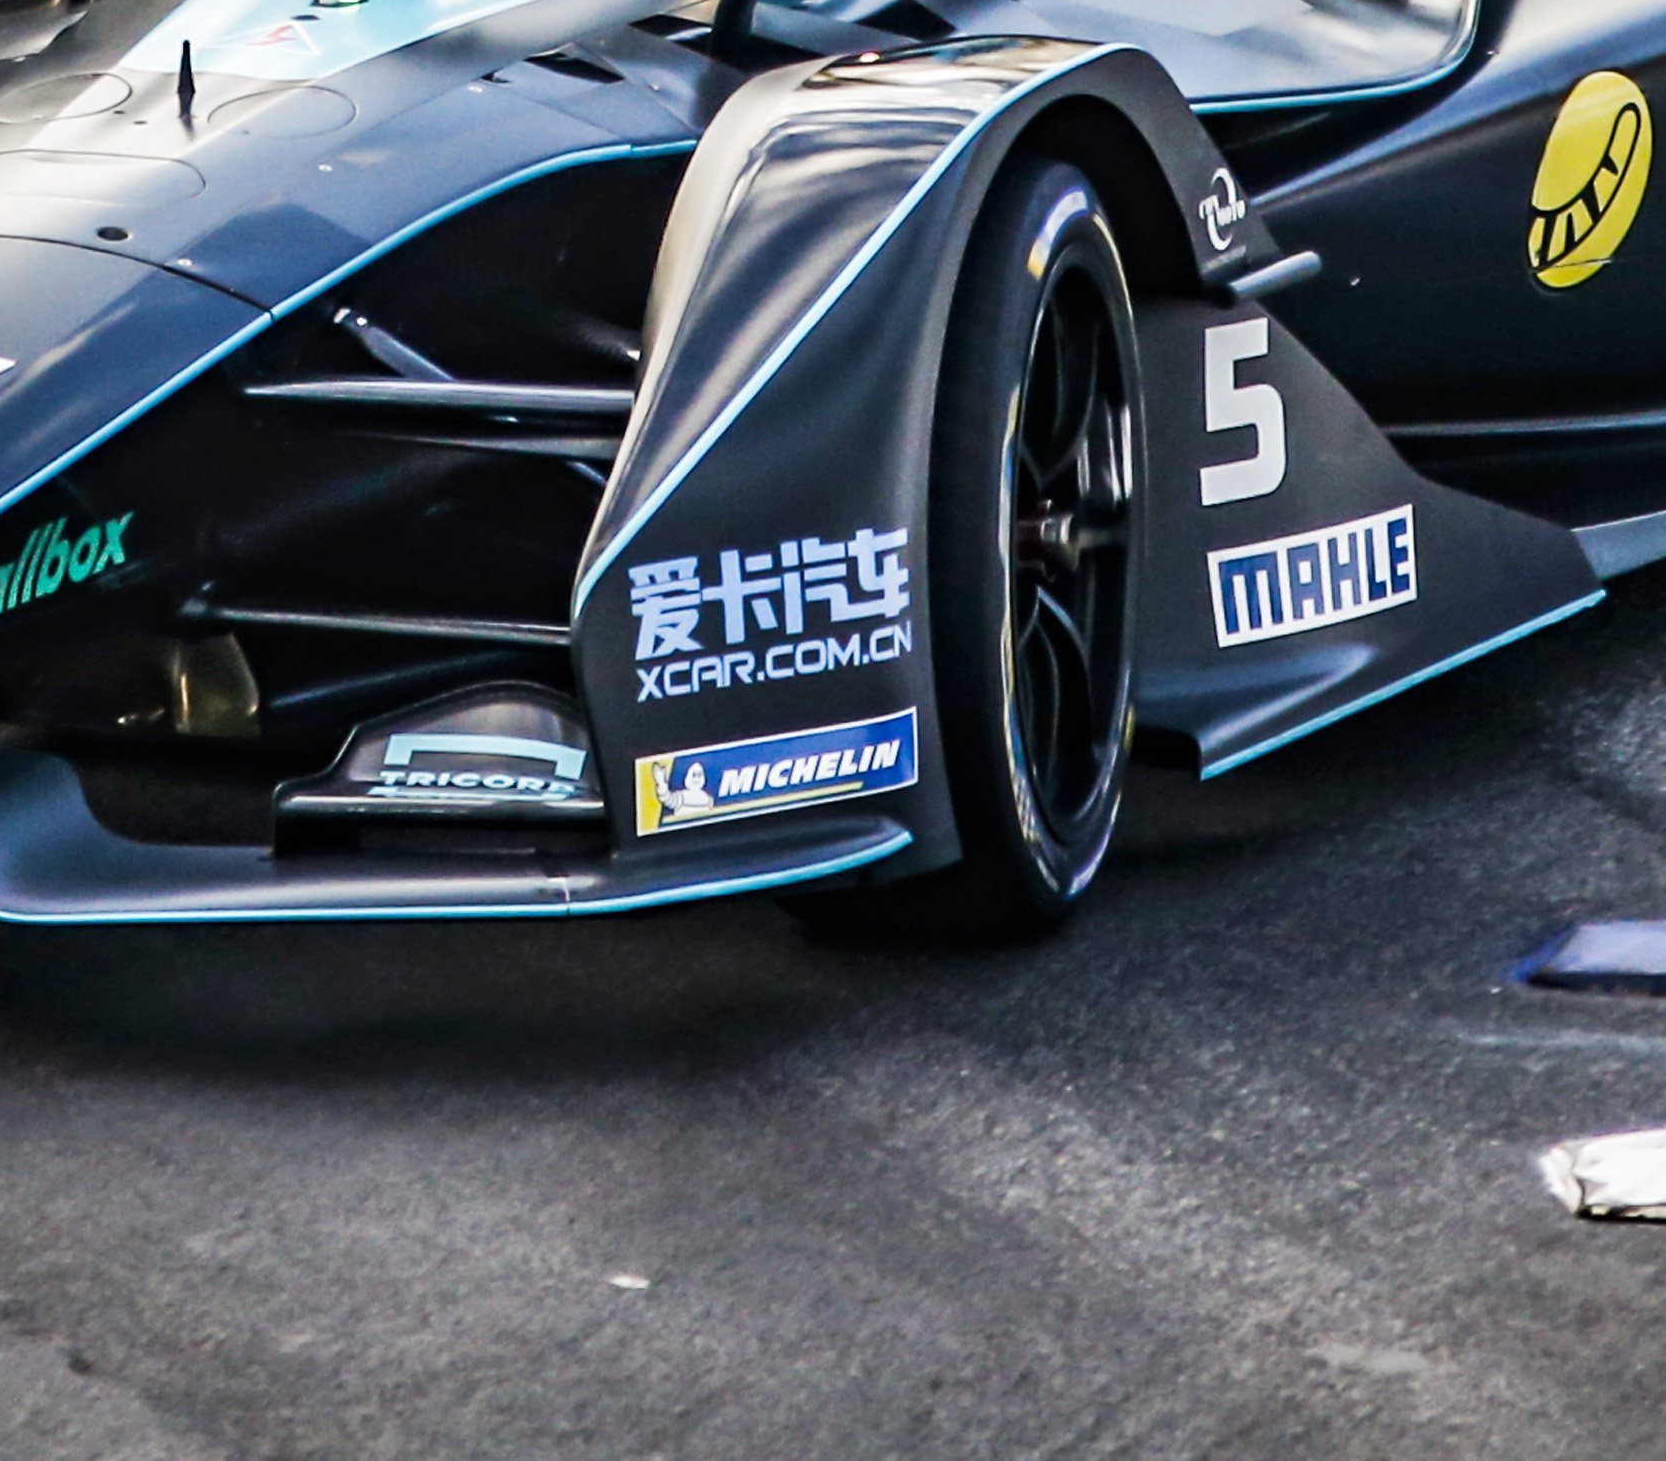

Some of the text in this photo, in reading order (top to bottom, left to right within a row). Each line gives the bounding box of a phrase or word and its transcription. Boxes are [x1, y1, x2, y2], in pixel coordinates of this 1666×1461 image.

[1199, 316, 1286, 507] 5
[628, 527, 911, 661] 爱卡汽车
[1217, 516, 1412, 636] MAHLE
[635, 620, 913, 704] XCAR.COM.CN
[379, 769, 576, 795] TRICORP
[717, 739, 901, 798] MICHELIN
